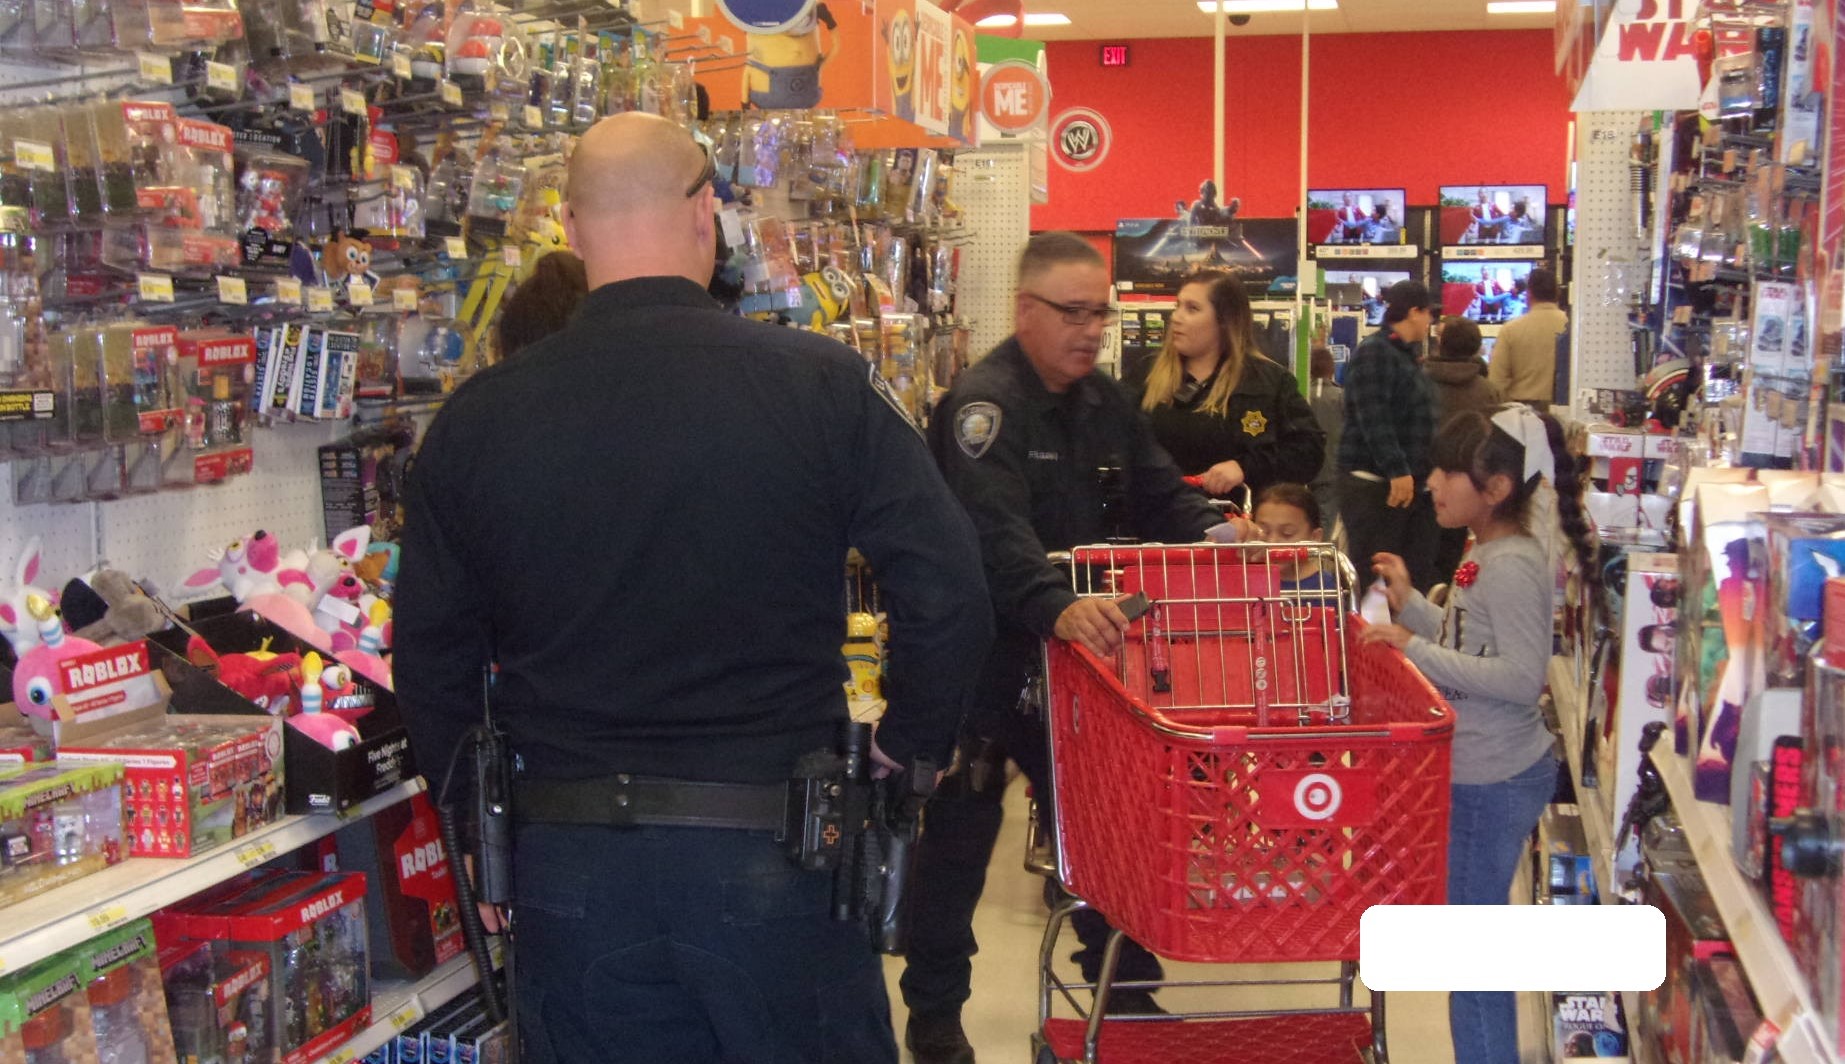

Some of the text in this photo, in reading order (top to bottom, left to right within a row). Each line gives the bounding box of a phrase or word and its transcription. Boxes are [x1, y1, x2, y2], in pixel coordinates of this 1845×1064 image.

[1104, 46, 1127, 65] EXIT
[920, 31, 944, 122] ME
[994, 89, 1028, 117] ME
[183, 127, 226, 146] ROBLOX
[136, 332, 174, 347] ROBLOX
[204, 344, 249, 361] ROBLOX
[69, 652, 142, 689] ROBLOX
[401, 838, 448, 879] ROBL
[300, 890, 343, 922] ROBLOX
[91, 934, 146, 972] MINECRAFT
[26, 971, 80, 1015] MINECRAFT
[223, 961, 263, 998] ROBLOX
[1560, 1009, 1604, 1022] WAR
